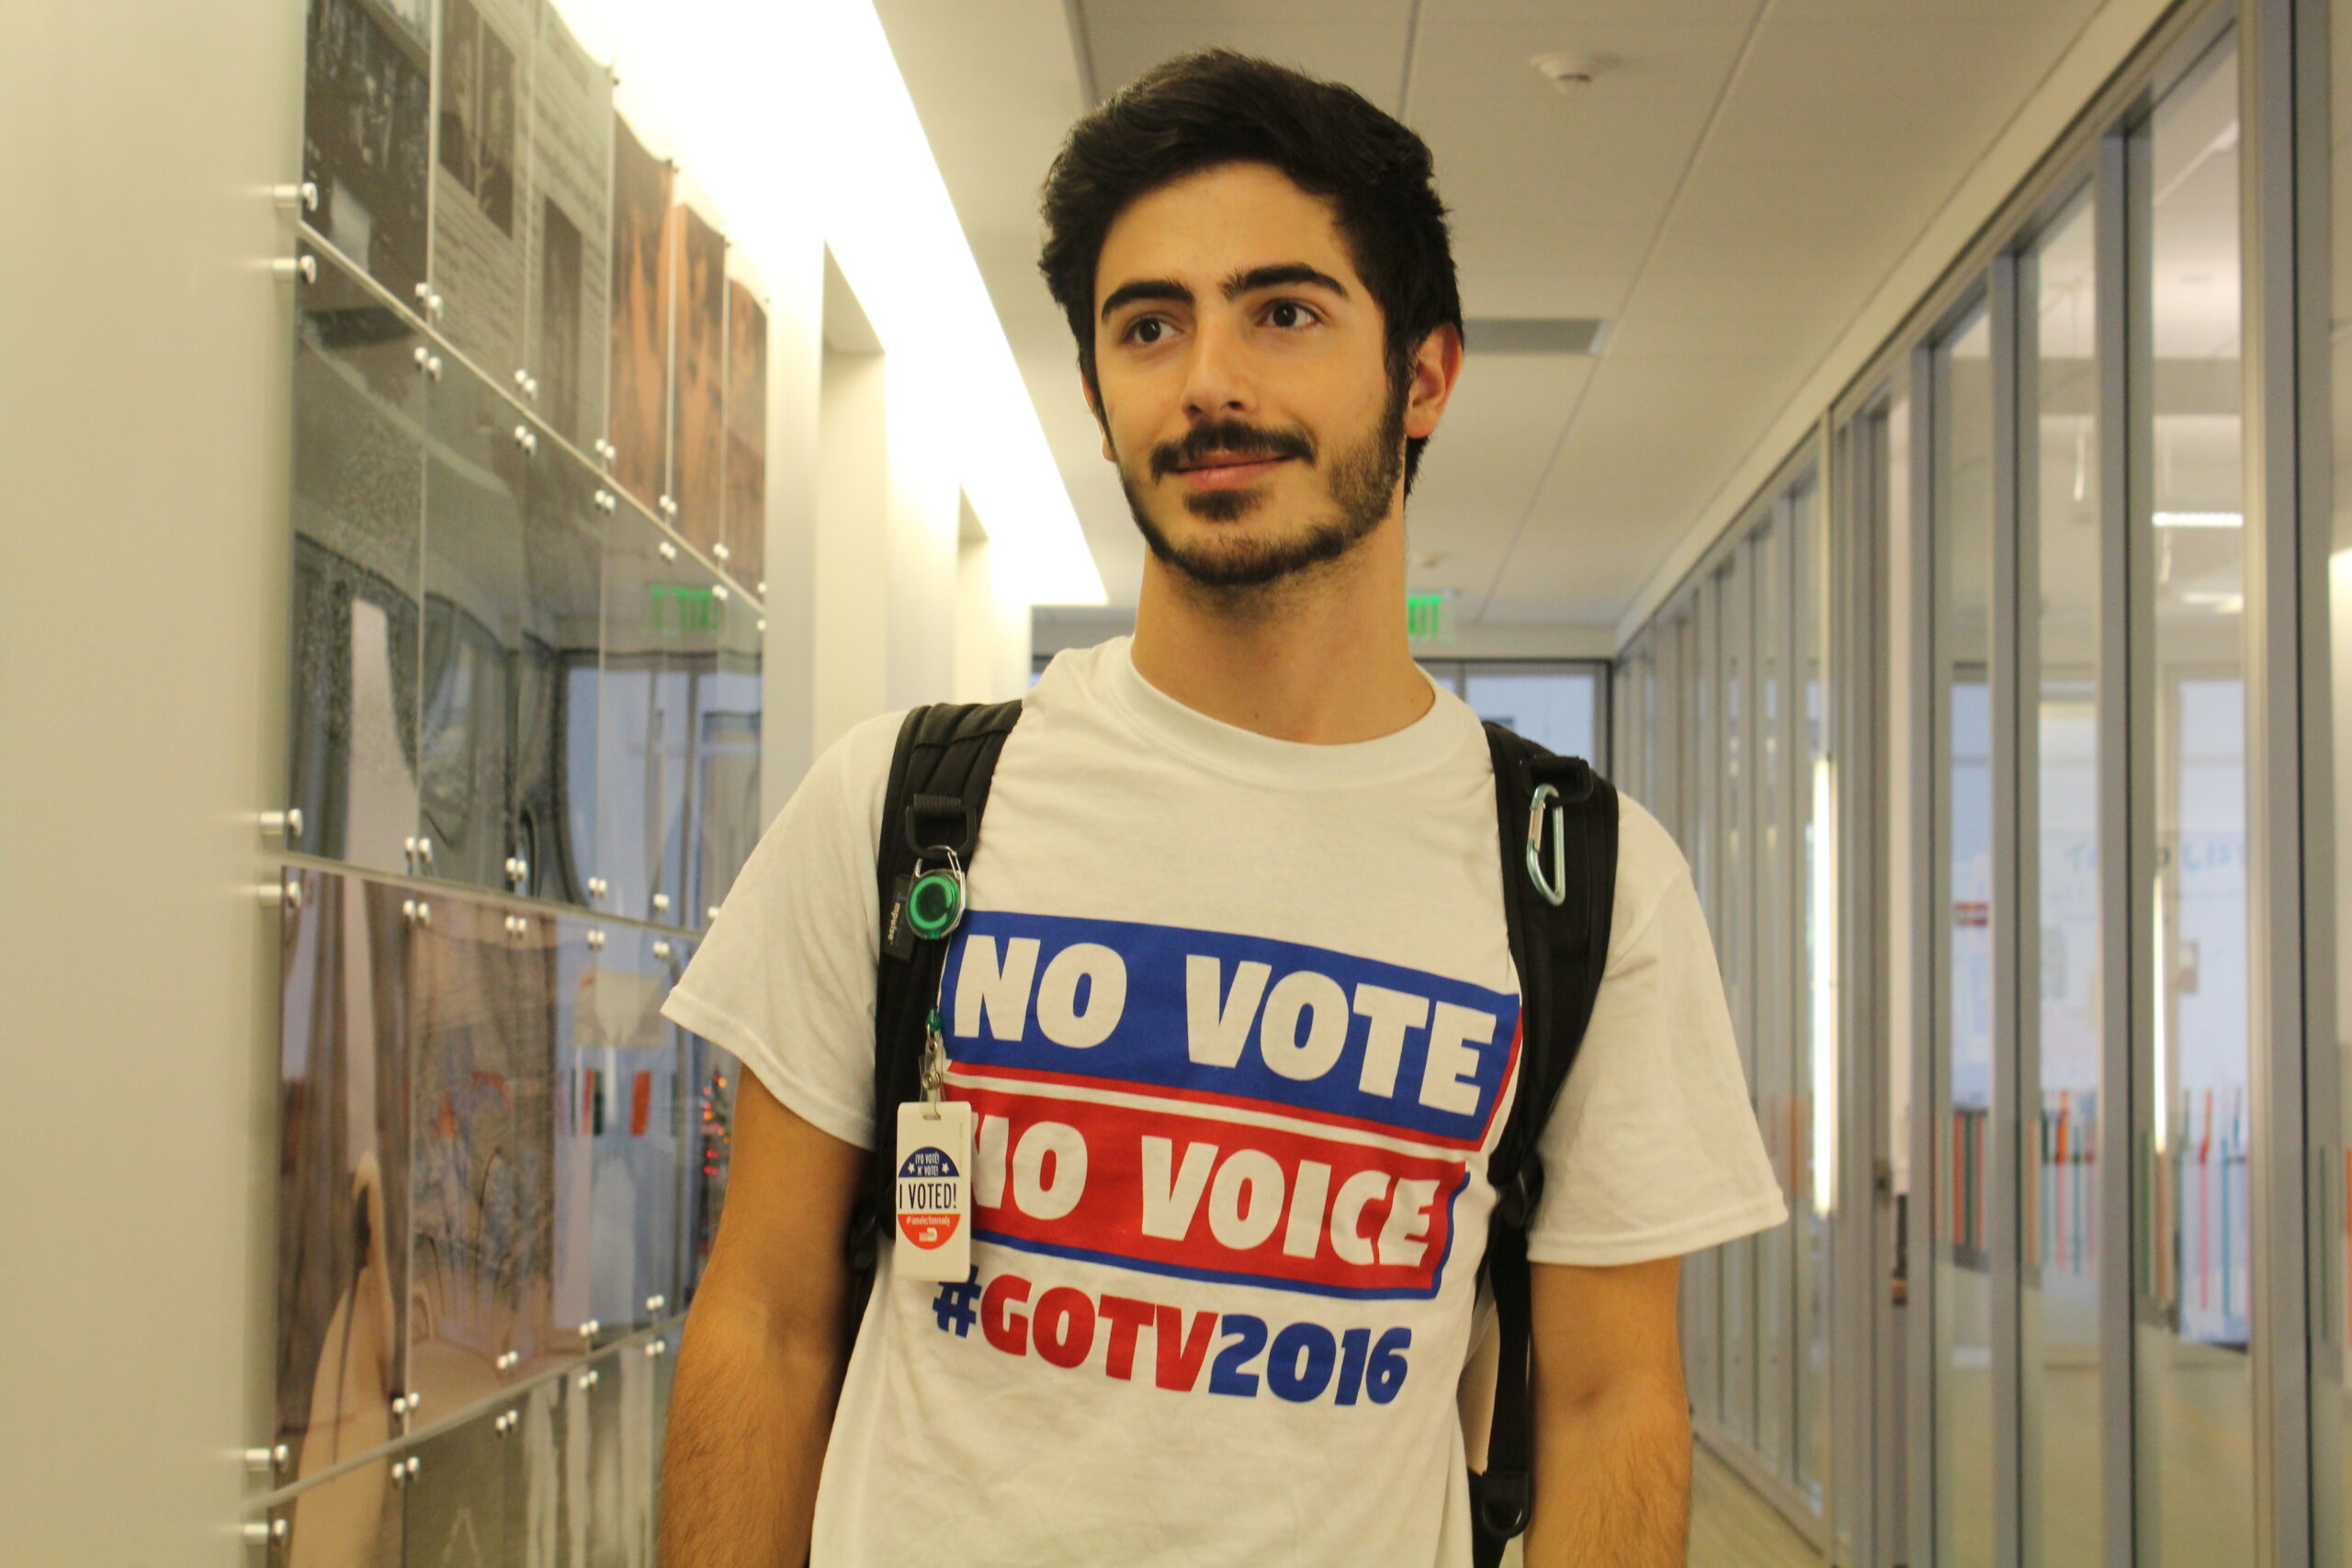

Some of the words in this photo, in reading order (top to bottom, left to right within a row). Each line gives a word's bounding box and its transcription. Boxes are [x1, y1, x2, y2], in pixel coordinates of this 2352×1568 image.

[953, 933, 1127, 1049] NO
[1185, 953, 1498, 1117] VOTE
[899, 1183, 902, 1210] I
[909, 1183, 956, 1210] VOTED!
[1140, 1134, 1441, 1269] VOICE
[932, 1264, 1413, 1406] #GOTV2016
